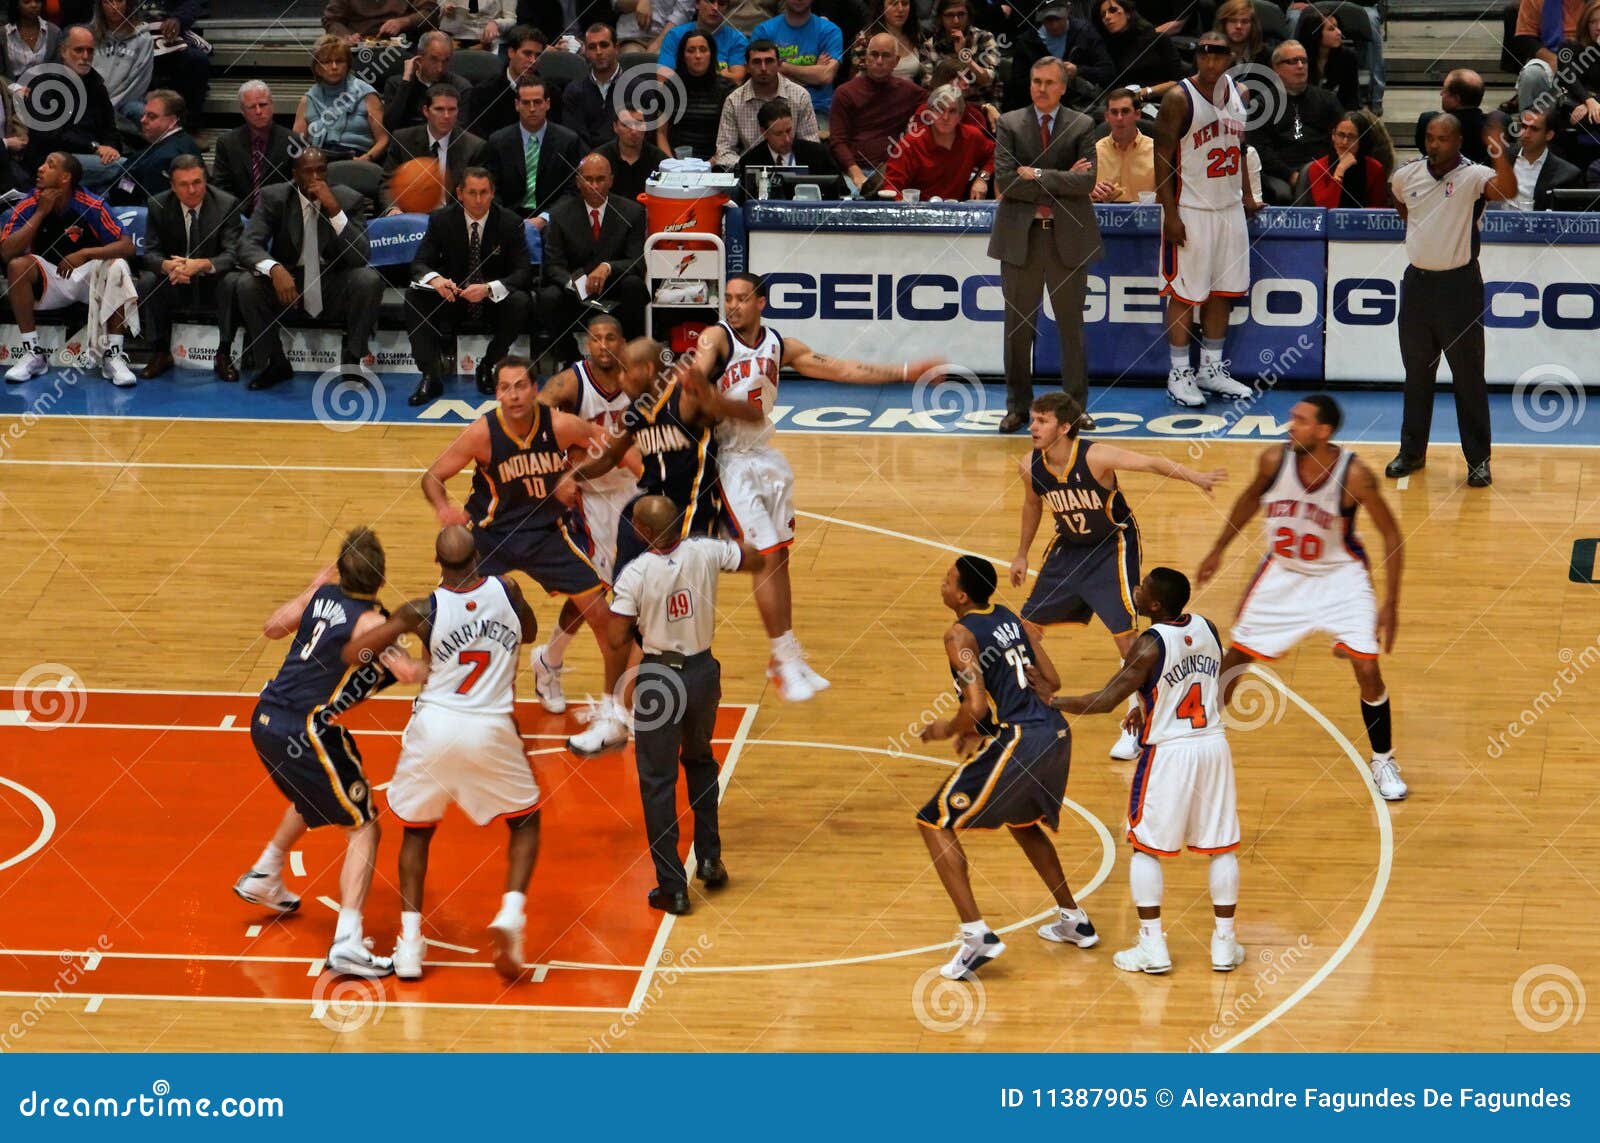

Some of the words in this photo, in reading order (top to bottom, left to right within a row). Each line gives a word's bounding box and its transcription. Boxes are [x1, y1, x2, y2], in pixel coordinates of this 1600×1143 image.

[1206, 146, 1241, 178] 23
[370, 231, 426, 248] mtrak.co
[1333, 277, 1600, 330] GCO
[721, 359, 752, 394] NEW
[498, 451, 565, 483] INDIANA
[522, 477, 548, 499] 10
[1062, 512, 1092, 534] 12
[1273, 526, 1323, 561] 20
[669, 592, 689, 618] 49
[299, 619, 327, 661] 3
[455, 650, 492, 694] 7
[1163, 654, 1219, 688] ROBINSON
[1175, 681, 1208, 730] 4
